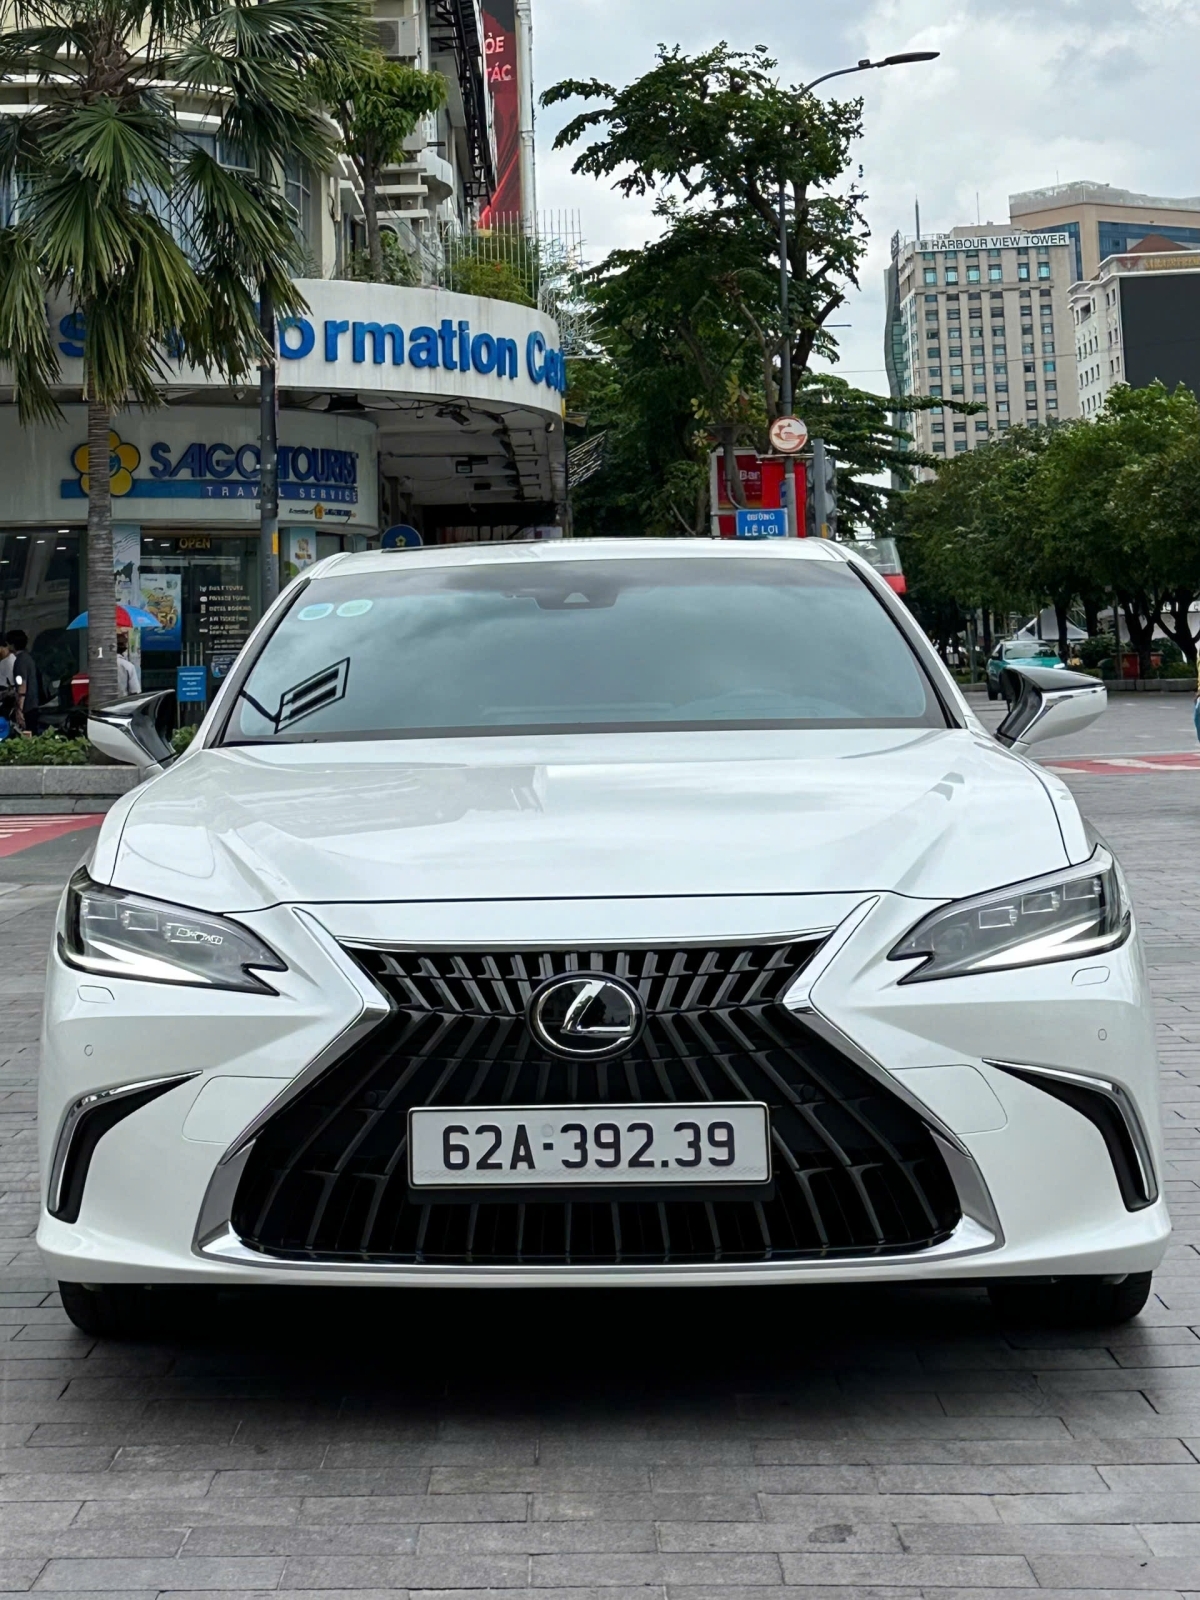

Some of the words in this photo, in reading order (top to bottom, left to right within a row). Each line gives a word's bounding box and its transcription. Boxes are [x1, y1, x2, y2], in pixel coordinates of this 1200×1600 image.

[932, 238, 988, 250] HARBOUR
[990, 236, 1020, 247] VIEW
[1023, 234, 1067, 246] TOWER
[149, 442, 359, 485] SAIGOTOURIST
[206, 486, 285, 498] TRAVL
[299, 488, 358, 503] SERVICE
[179, 538, 211, 549] OPEN
[442, 1121, 736, 1171] 62A-392.39
